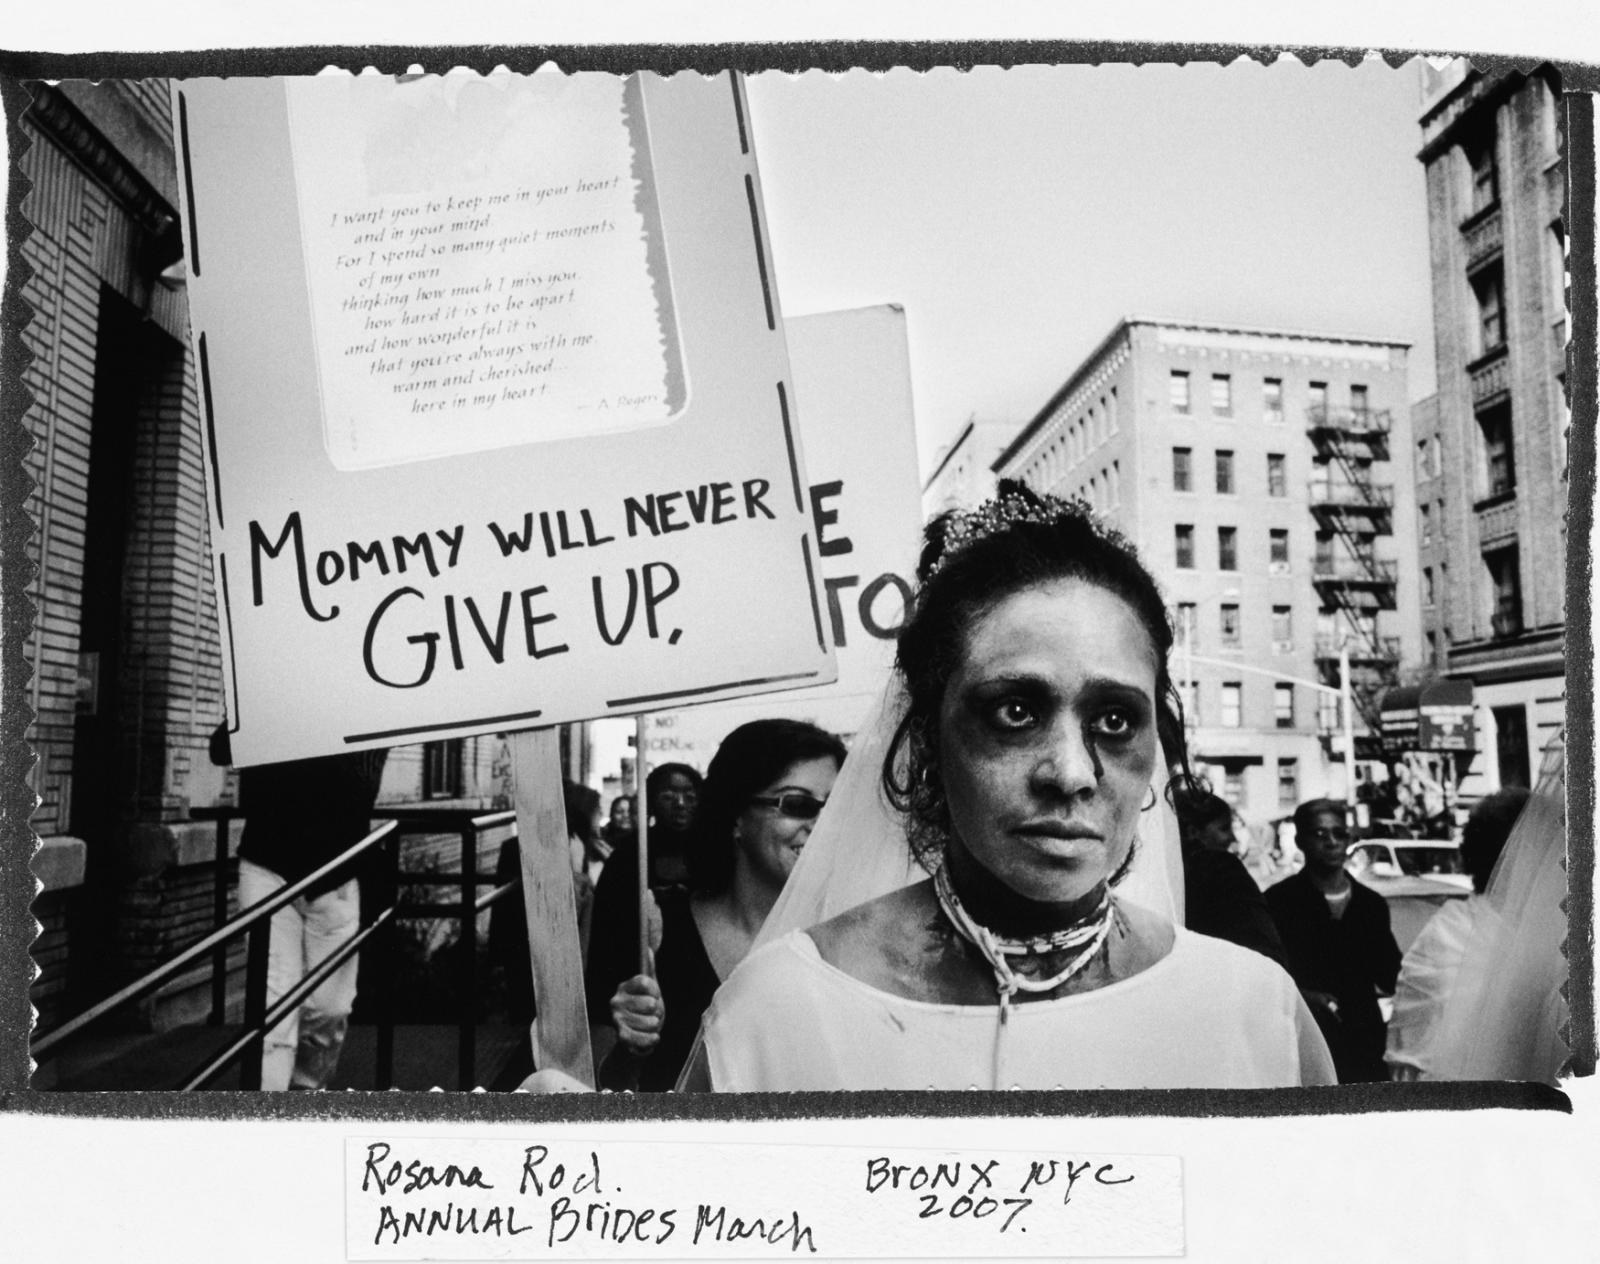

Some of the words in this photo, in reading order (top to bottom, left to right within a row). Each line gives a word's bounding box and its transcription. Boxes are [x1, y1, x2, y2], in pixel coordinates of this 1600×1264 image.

[344, 206, 384, 225] want
[390, 207, 420, 225] you
[426, 201, 441, 214] to
[446, 196, 483, 213] keep
[488, 193, 511, 204] me
[516, 187, 531, 201] in
[535, 186, 569, 206] your
[576, 175, 619, 193] heart
[336, 253, 362, 269] For
[368, 251, 376, 266] I
[382, 243, 427, 266] spend
[431, 245, 446, 256] so
[451, 240, 495, 256] many
[498, 229, 538, 253] quiet
[546, 219, 615, 241] moments
[353, 227, 386, 244] and
[391, 227, 404, 241] in
[409, 224, 444, 243] your
[341, 291, 409, 312] thinking
[416, 287, 447, 301] how
[451, 277, 493, 297] much
[498, 277, 506, 292] I
[511, 272, 543, 289] miss
[359, 271, 376, 289] of
[380, 273, 404, 290] my
[408, 268, 440, 281] own
[364, 316, 395, 330] how
[401, 307, 442, 326] hard
[445, 306, 458, 320] it
[464, 302, 479, 317] is
[485, 302, 501, 315] to
[506, 295, 525, 311] be
[344, 338, 376, 356] and
[381, 336, 414, 350] how
[418, 319, 504, 345] wonderful
[506, 319, 520, 334] it
[526, 316, 538, 330] is
[370, 358, 404, 376] that
[467, 344, 524, 362] always
[530, 333, 568, 351] with
[393, 379, 438, 393] warm
[442, 368, 475, 387] and
[411, 398, 447, 413] here
[452, 393, 467, 408] in
[473, 393, 497, 410] my
[487, 508, 615, 558] WILL
[623, 478, 777, 537] NEVER
[362, 585, 570, 689] GIVE
[1022, 1161, 1135, 1204] NYC
[693, 1207, 819, 1254] March
